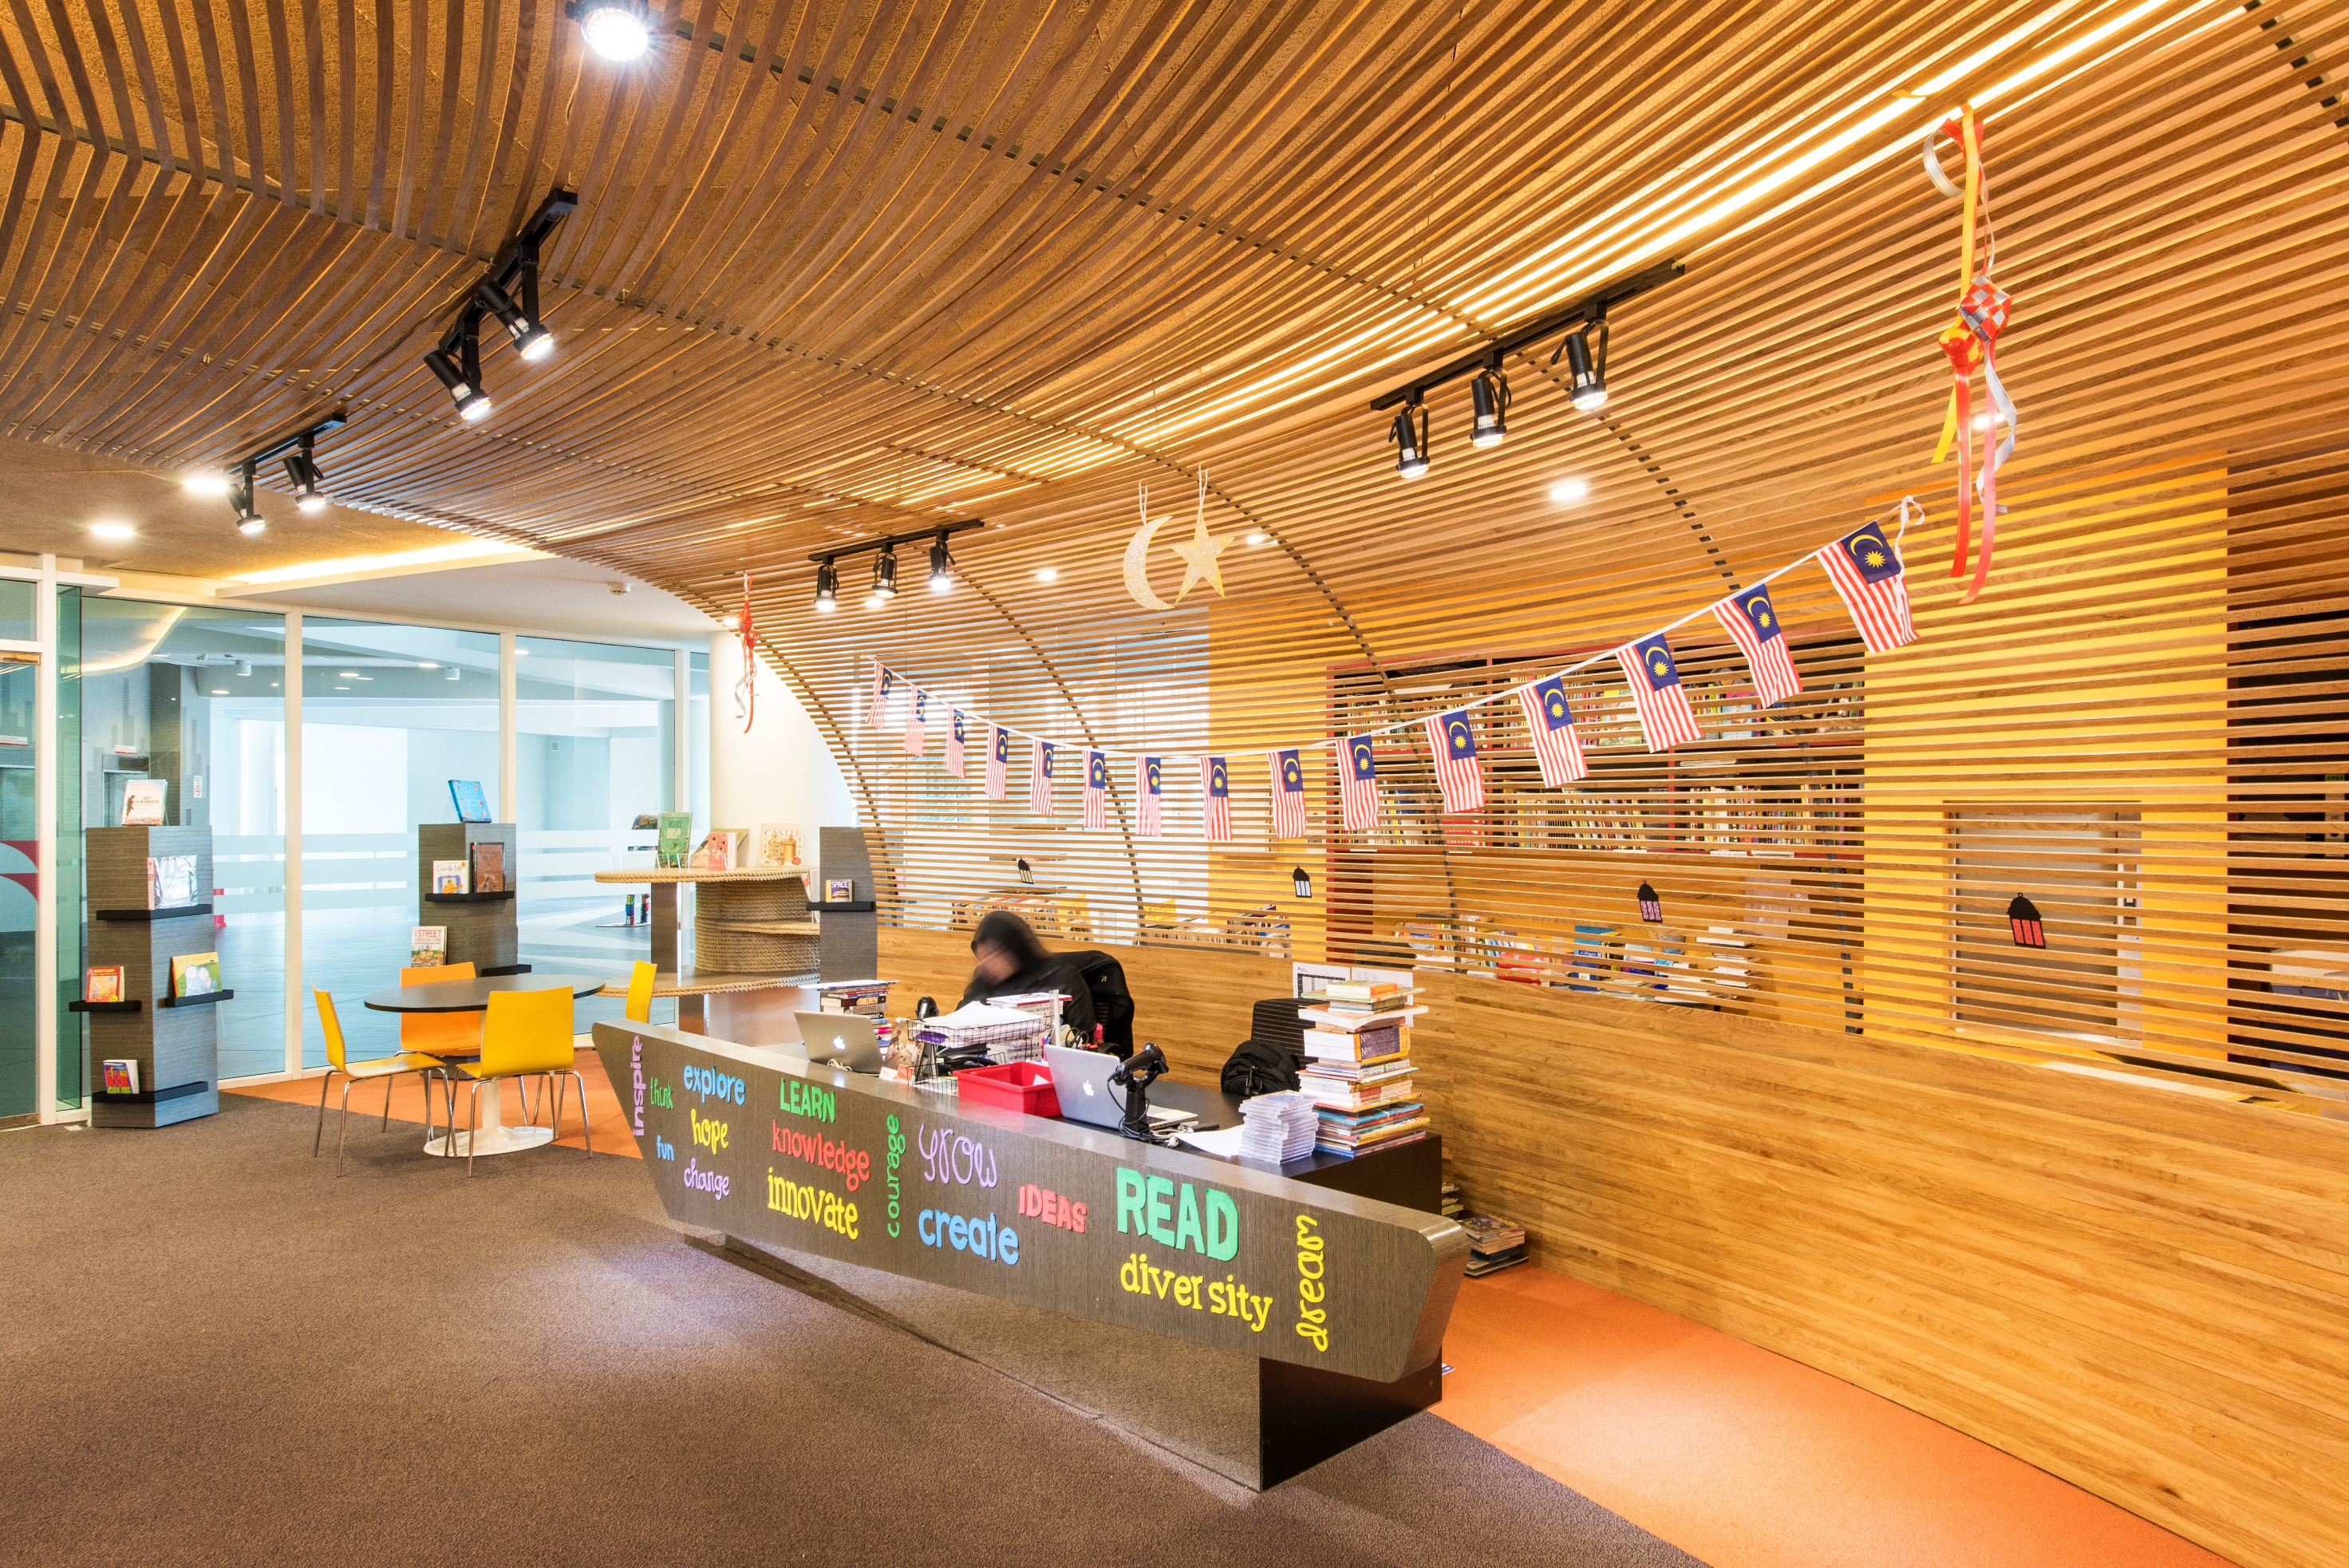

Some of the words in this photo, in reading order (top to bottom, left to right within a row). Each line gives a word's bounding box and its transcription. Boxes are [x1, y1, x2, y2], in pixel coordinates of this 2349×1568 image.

[417, 929, 442, 938] STREET
[631, 1035, 645, 1136] inspire
[649, 1077, 673, 1110] think
[683, 1064, 746, 1105] explore
[780, 1077, 836, 1124] LEARN
[656, 1134, 675, 1162] fun
[690, 1108, 729, 1155] hope
[771, 1118, 871, 1193] knowledge
[918, 1123, 998, 1189] grow
[683, 1157, 730, 1201] change
[767, 1166, 860, 1240] innovate
[886, 1112, 906, 1238] courage
[918, 1208, 1020, 1266] create
[1018, 1183, 1088, 1234] IDEAS
[1117, 1167, 1239, 1262] READ
[1119, 1251, 1273, 1333] diversity
[1295, 1213, 1329, 1353] dream
